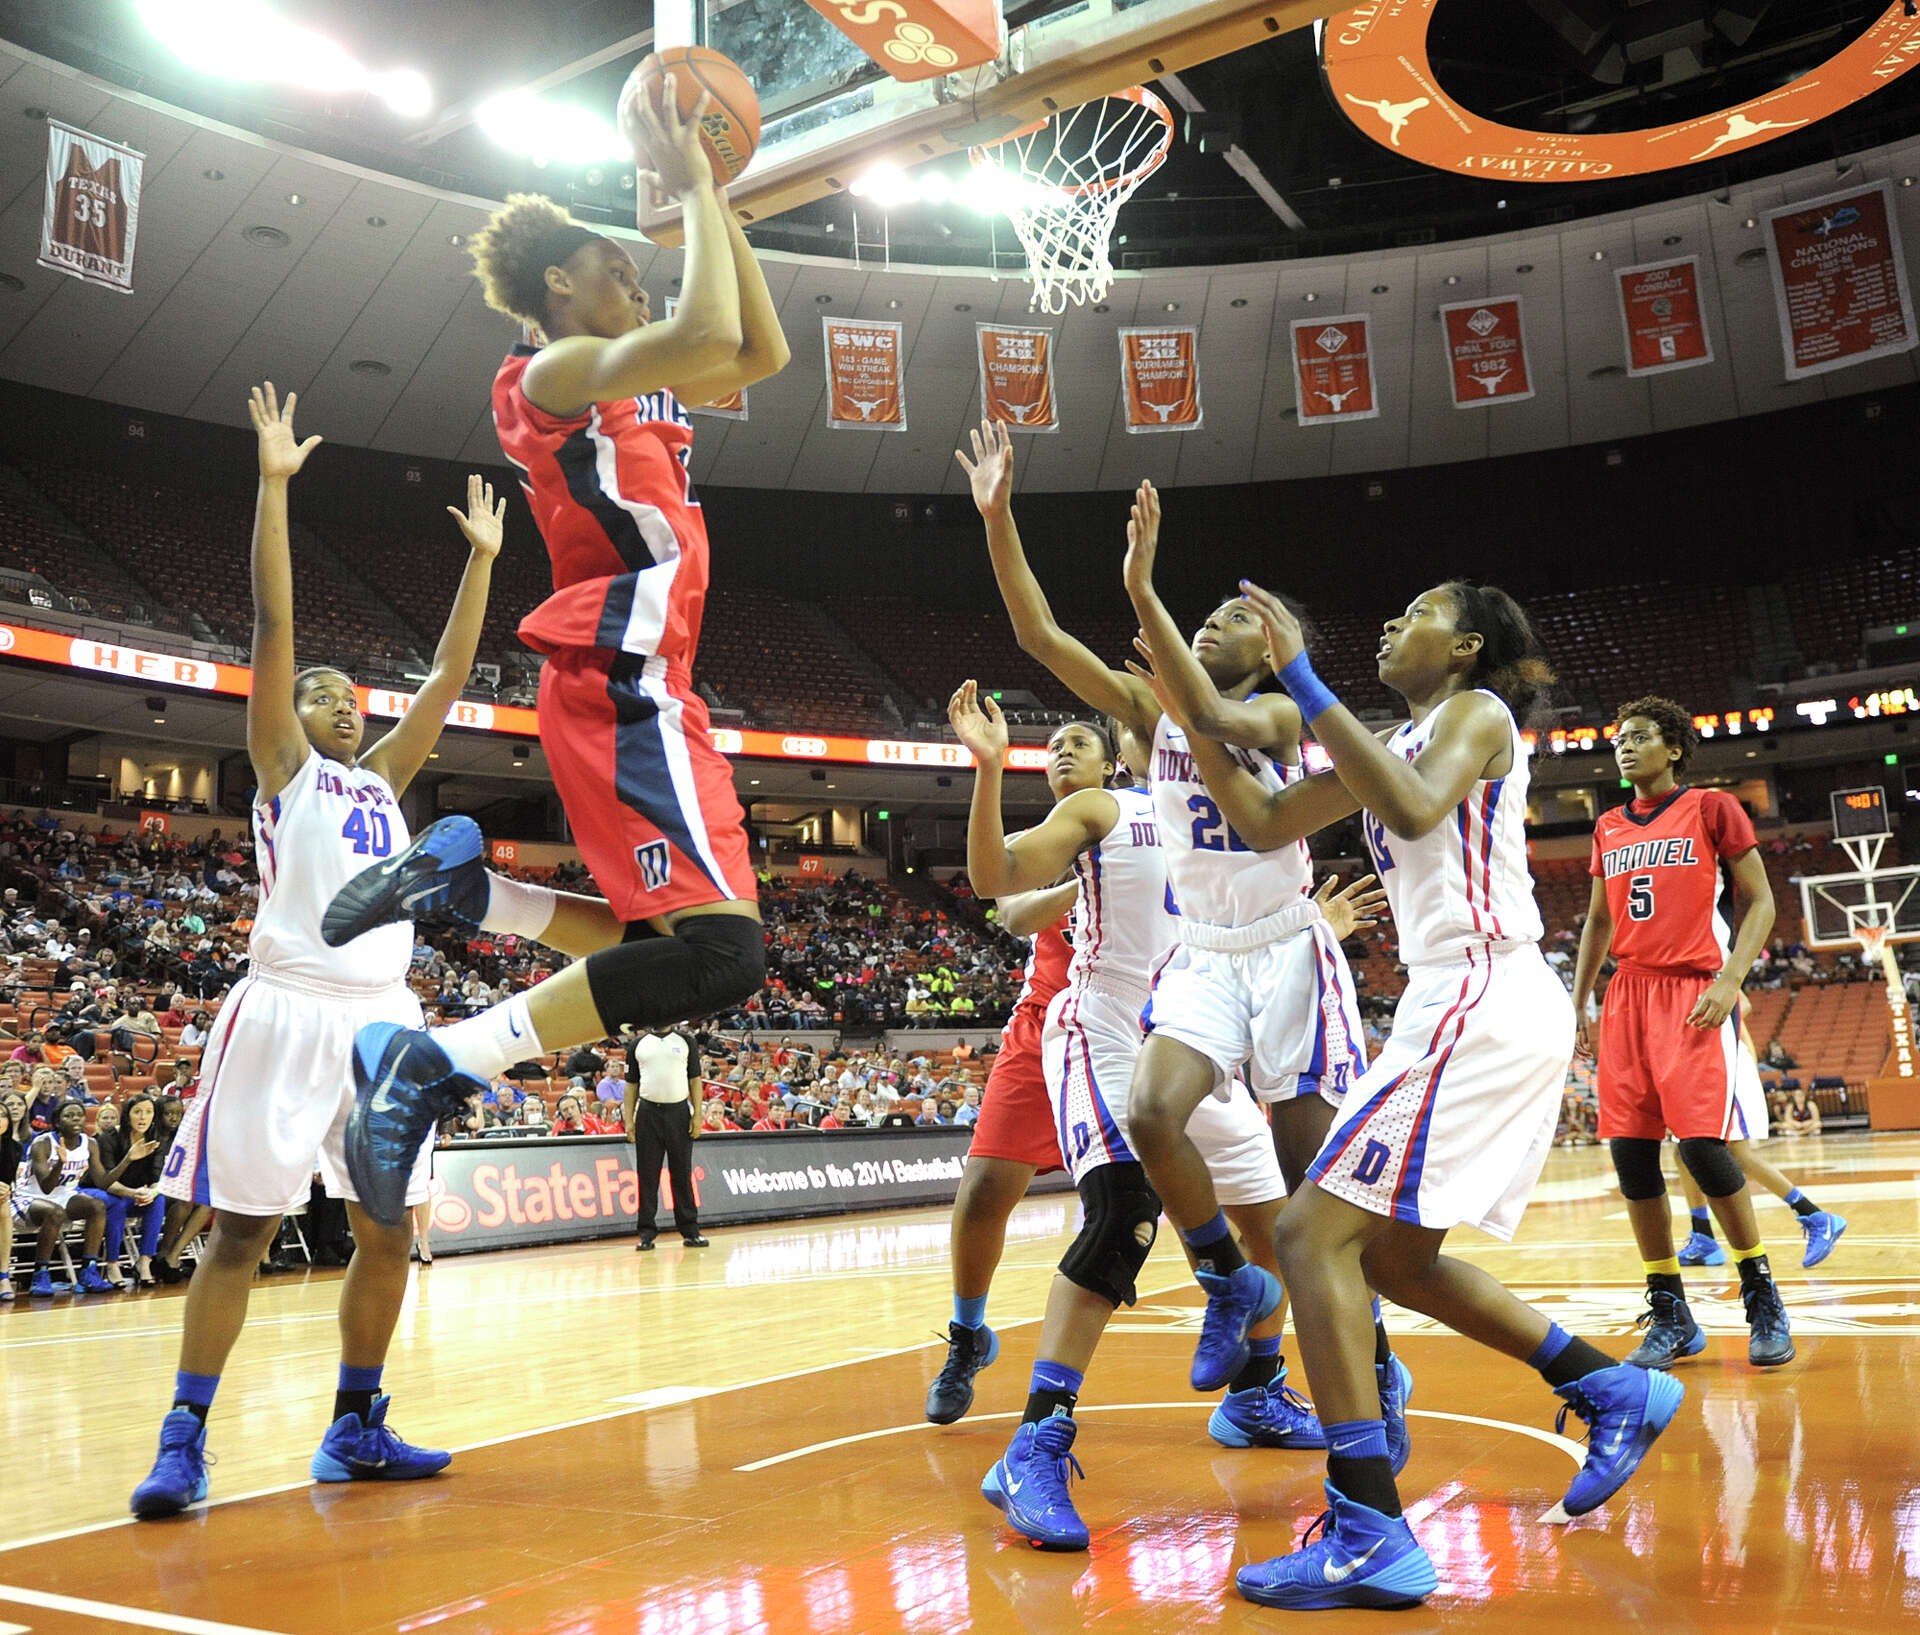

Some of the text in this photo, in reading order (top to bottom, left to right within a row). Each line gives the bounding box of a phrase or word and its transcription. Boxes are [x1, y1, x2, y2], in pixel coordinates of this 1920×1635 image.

[1339, 0, 1382, 45] CAL
[1514, 147, 1584, 157] HOUSE
[1457, 156, 1614, 175] CALLAWAY
[1509, 170, 1547, 179] THE
[74, 193, 107, 228] 35
[1791, 238, 1879, 268] CHAMPIONS
[1795, 232, 1868, 257] NATIONAL
[50, 243, 126, 279] DURANT
[833, 333, 893, 349] SWC
[1490, 339, 1517, 350] FOUR
[856, 365, 891, 373] STREAK
[861, 357, 888, 366] GAME
[988, 361, 1044, 374] CHAMPIONS
[1472, 359, 1507, 373] 1982
[1136, 371, 1187, 380] CHAMPIONS
[342, 806, 392, 857] 40
[496, 845, 514, 859] 48
[1602, 838, 1698, 880] MANVEL
[802, 860, 818, 872] 47
[1627, 874, 1654, 921] 5
[1890, 1003, 1914, 1077] TEXAS
[1073, 1121, 1090, 1160] D
[165, 1145, 186, 1178] D
[1350, 1137, 1391, 1186] D
[722, 1156, 964, 1195] Welcome to the 2014 Basketball
